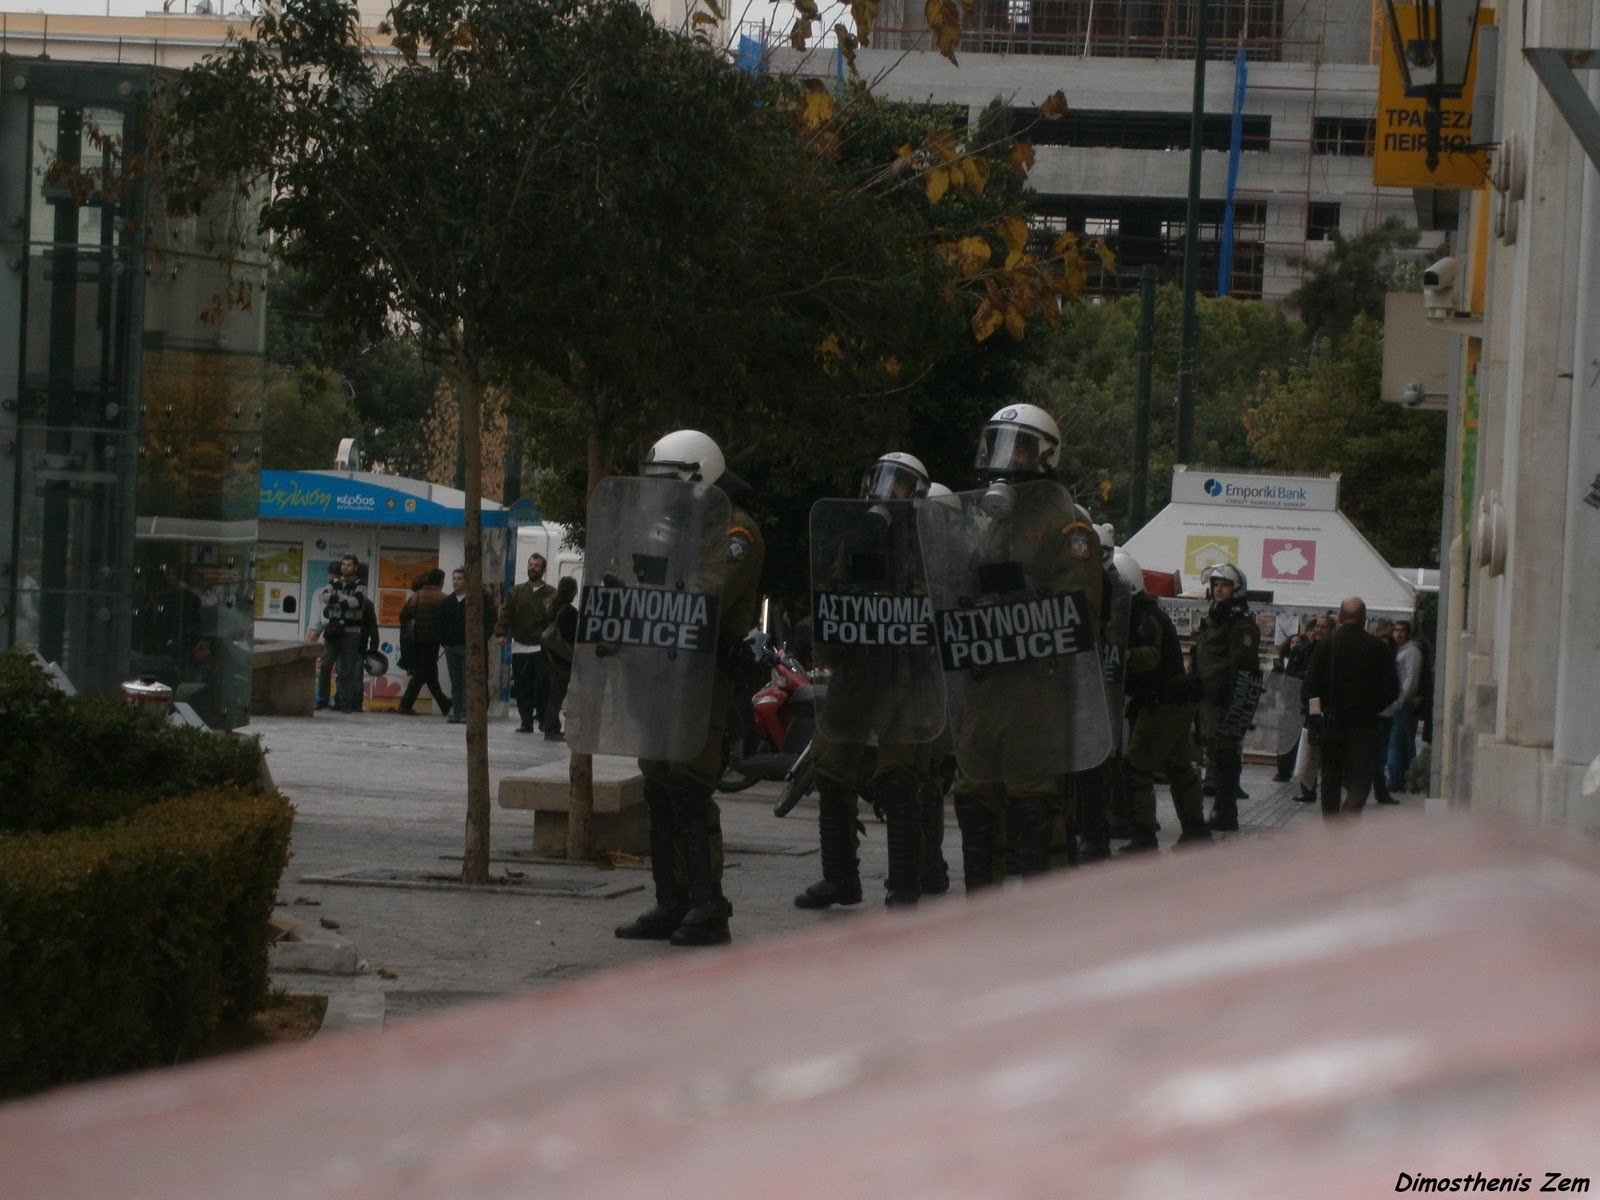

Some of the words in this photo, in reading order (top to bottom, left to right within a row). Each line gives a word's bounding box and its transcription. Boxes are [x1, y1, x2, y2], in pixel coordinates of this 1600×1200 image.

[336, 494, 375, 506] κέρδος
[1226, 484, 1276, 499] Emporiki
[1278, 487, 1307, 500] Bank
[584, 587, 708, 626] ΑΣΤΥΝΟΜΙΑ
[818, 593, 934, 623] ΑΣΤΥΝΟΜΙΑ
[943, 595, 1081, 642] ΑΣΤΥΝΟΜΙΑ
[585, 617, 699, 650] POLICE
[822, 620, 928, 645] POLICE
[950, 627, 1078, 668] POLICE
